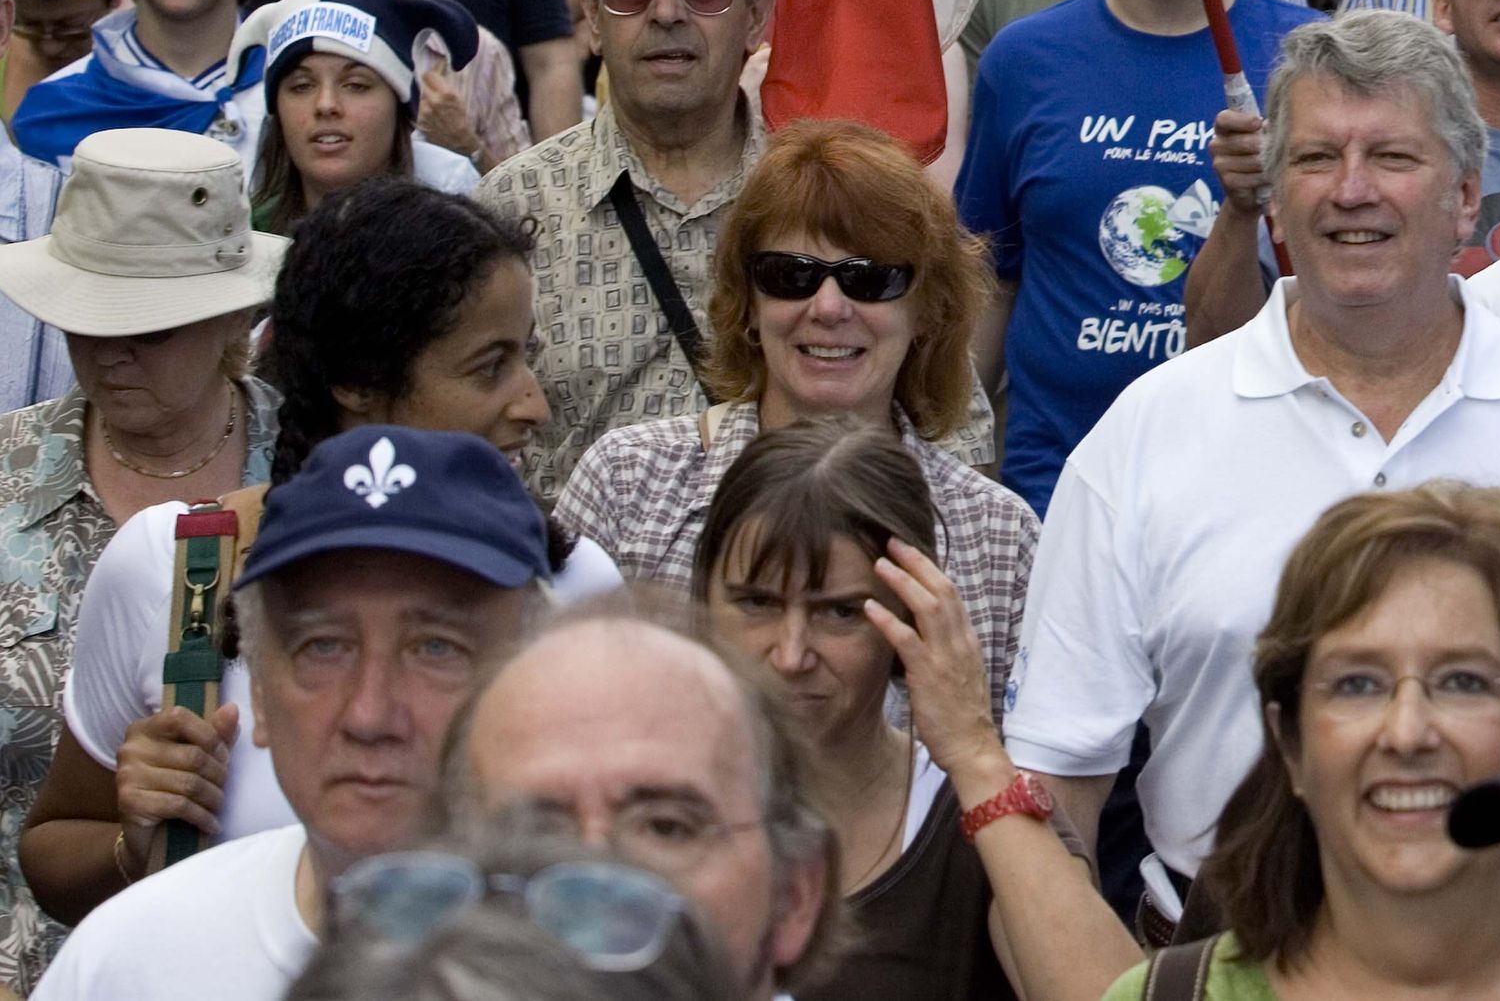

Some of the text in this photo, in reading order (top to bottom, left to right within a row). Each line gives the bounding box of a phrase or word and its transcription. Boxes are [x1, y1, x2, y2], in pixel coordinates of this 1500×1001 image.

[1080, 115, 1216, 151] UN PAY
[1077, 317, 1188, 359] BIENTÔ
